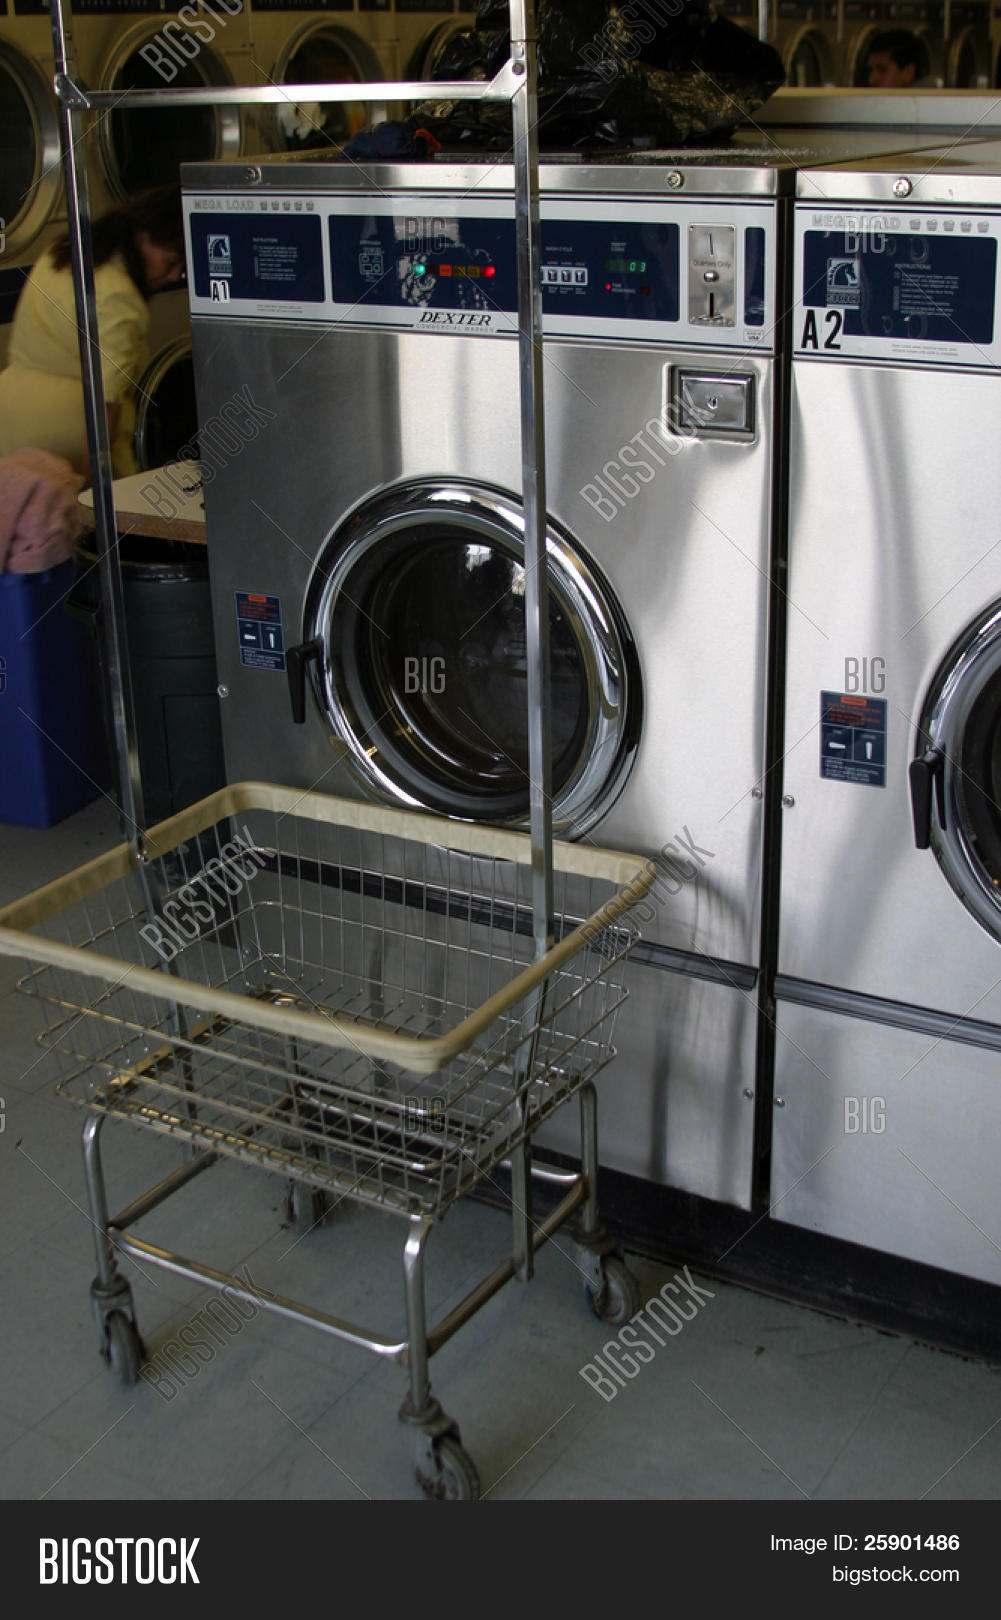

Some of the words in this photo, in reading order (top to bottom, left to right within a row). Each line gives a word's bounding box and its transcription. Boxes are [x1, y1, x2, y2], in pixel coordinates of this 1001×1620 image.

[227, 200, 254, 210] LOAD
[212, 281, 228, 302] A1
[419, 311, 492, 327] DEXTER
[801, 308, 843, 350] A2
